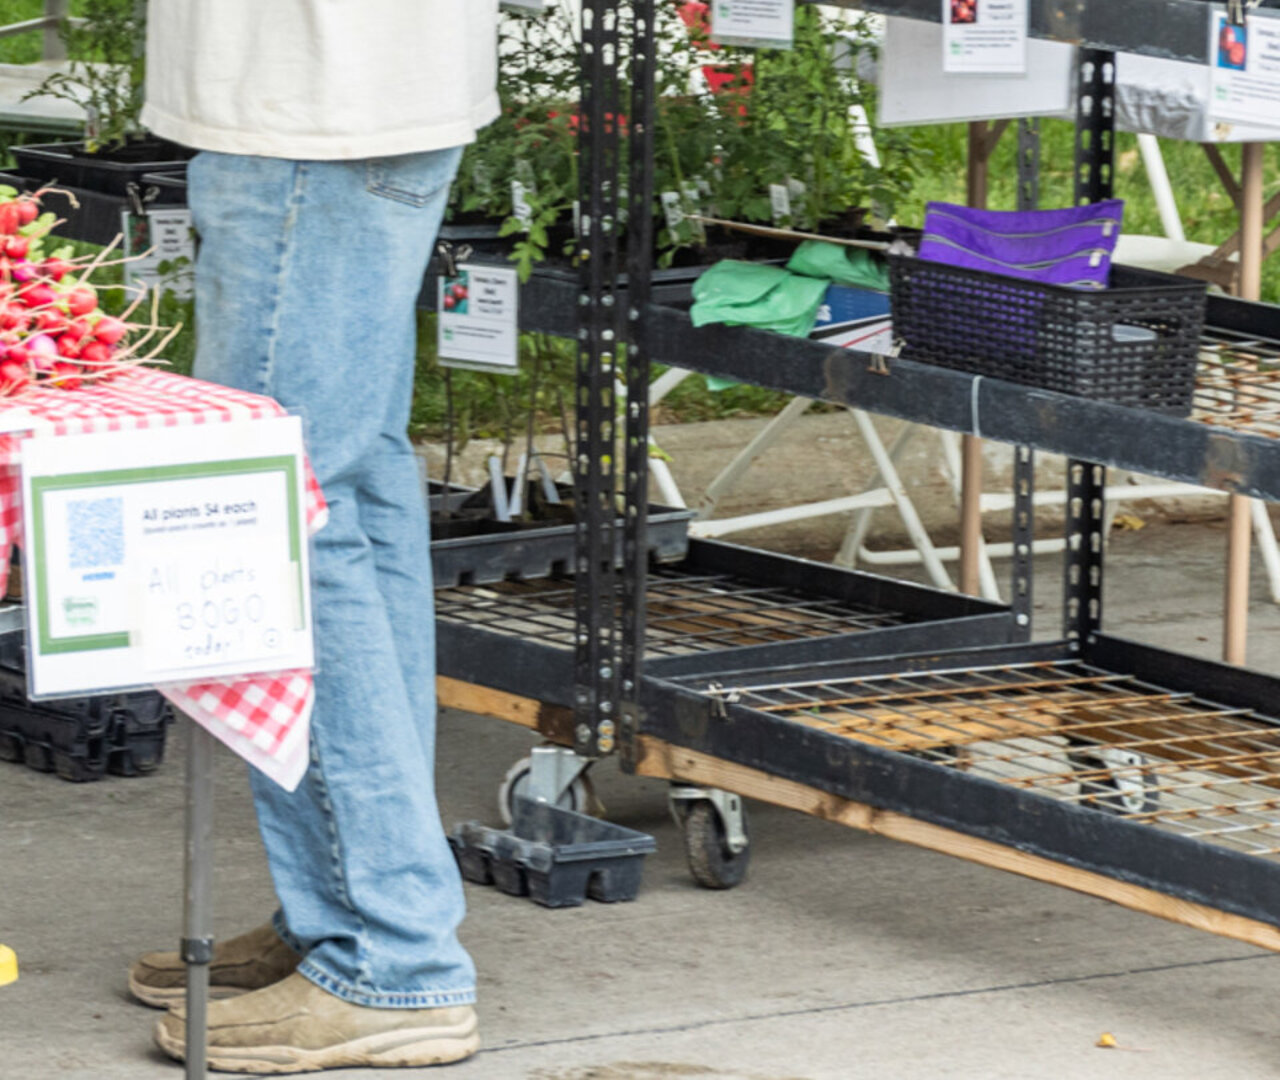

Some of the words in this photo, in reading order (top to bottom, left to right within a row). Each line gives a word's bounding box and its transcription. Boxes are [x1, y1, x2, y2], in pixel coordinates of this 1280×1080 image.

[143, 508, 157, 520] All
[163, 506, 200, 521] plants
[224, 499, 256, 514] each
[176, 593, 264, 631] BOGO
